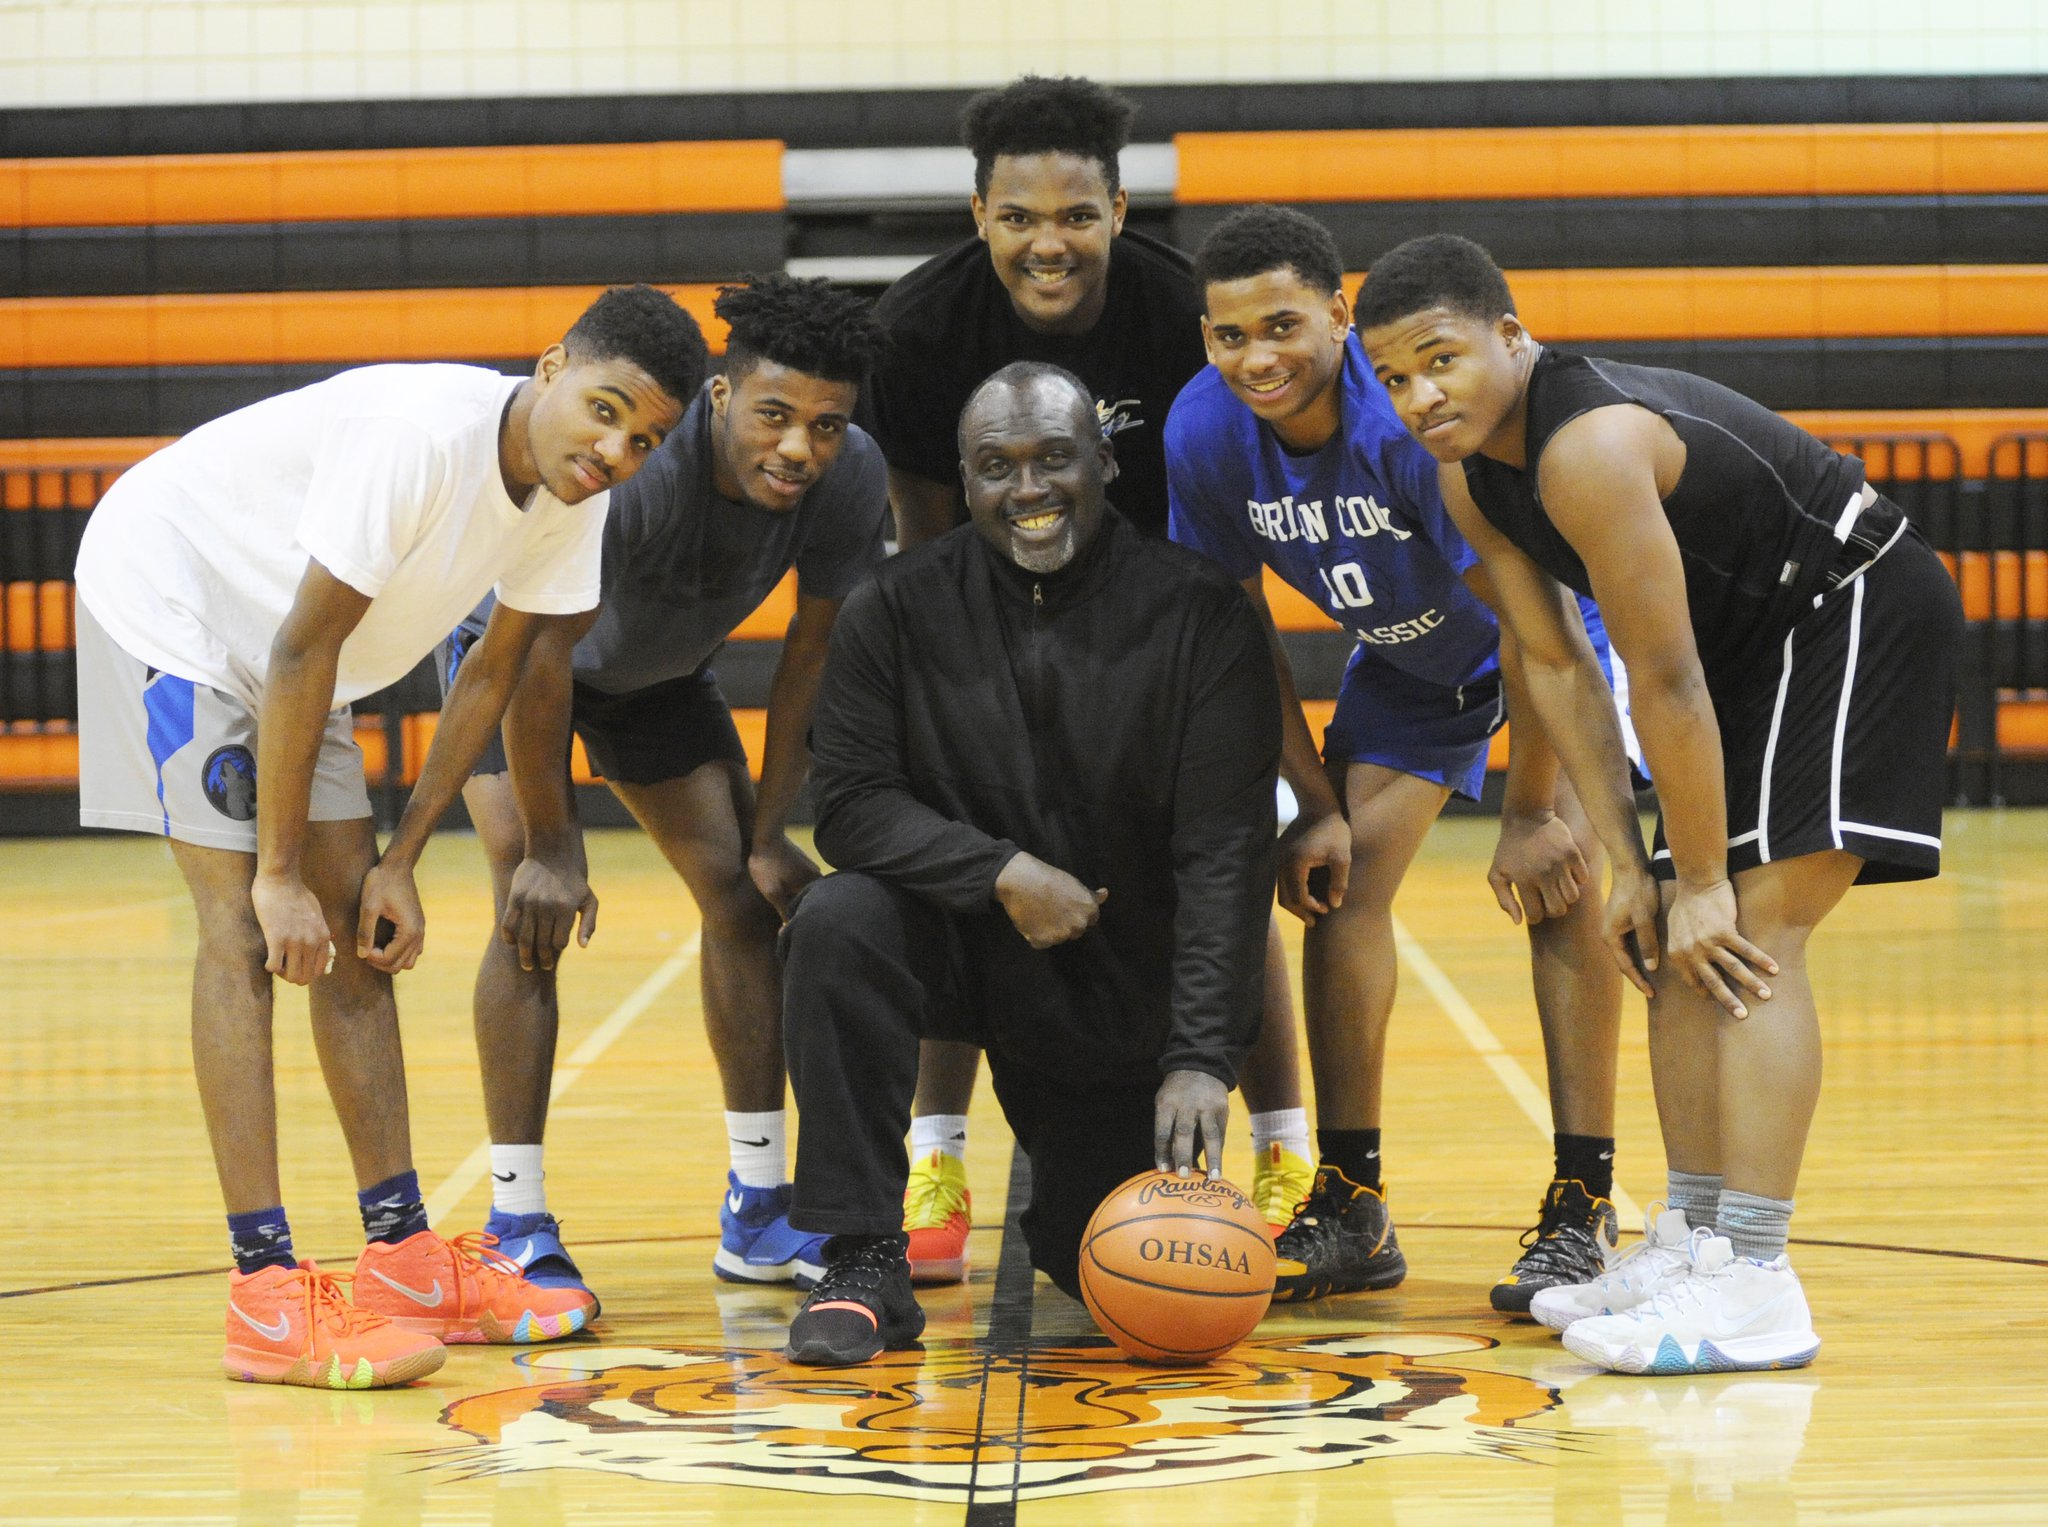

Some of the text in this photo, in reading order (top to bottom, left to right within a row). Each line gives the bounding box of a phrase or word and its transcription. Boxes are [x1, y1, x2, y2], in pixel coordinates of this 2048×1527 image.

[1247, 496, 1330, 543] BRIN
[1319, 562, 1374, 610] 10
[1138, 1178, 1254, 1210] Rawlings
[1139, 1238, 1251, 1276] OHSAA
